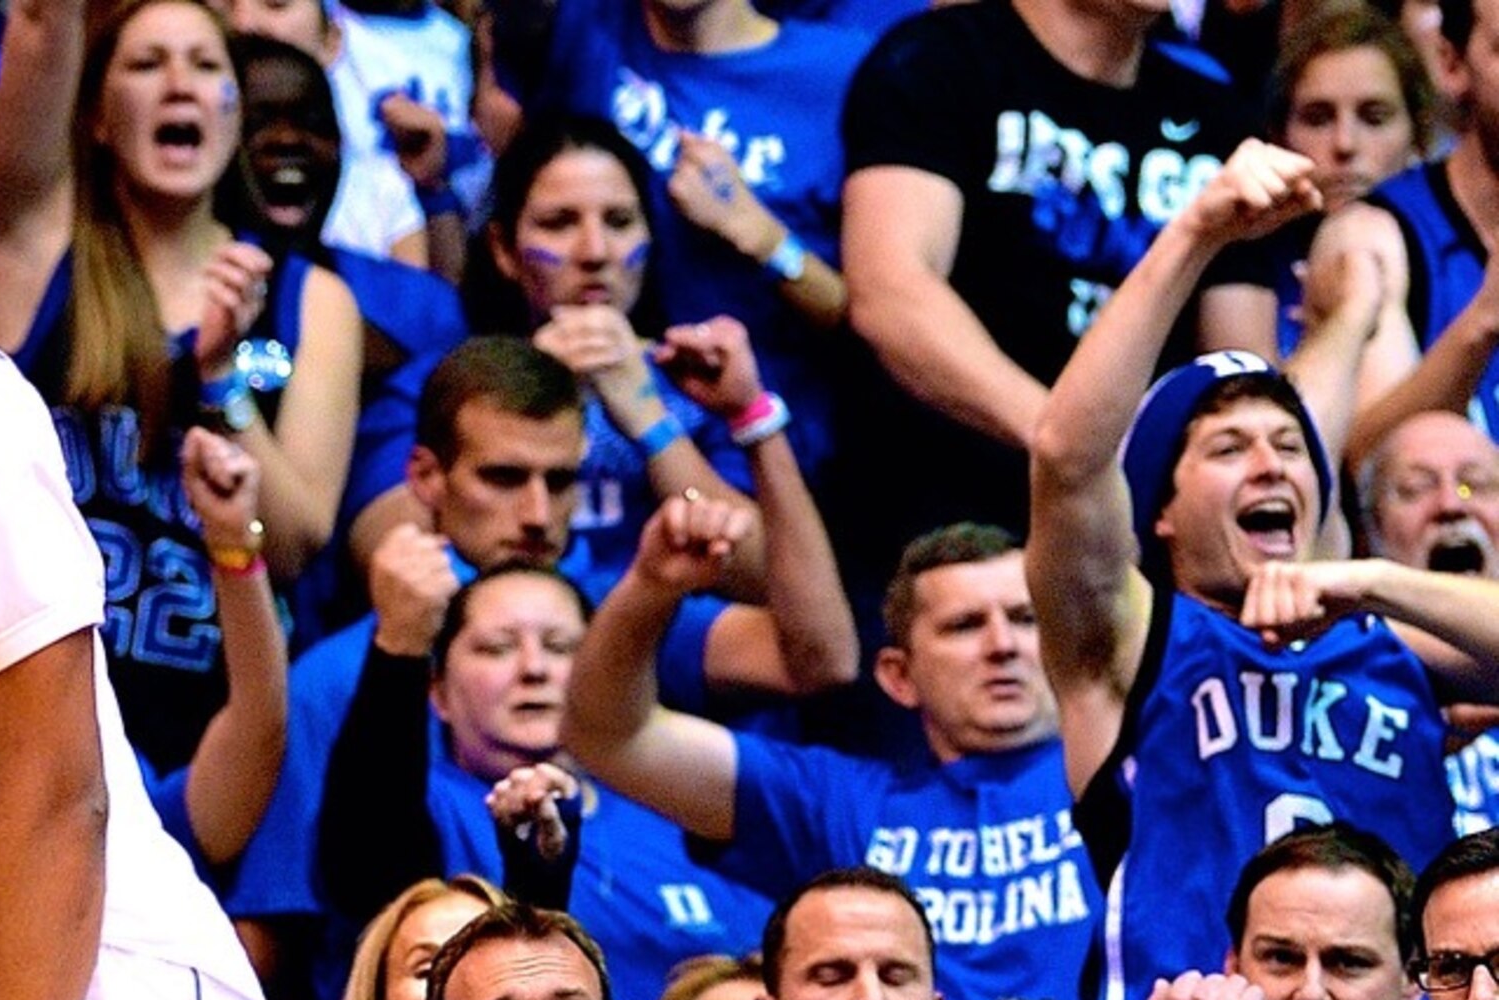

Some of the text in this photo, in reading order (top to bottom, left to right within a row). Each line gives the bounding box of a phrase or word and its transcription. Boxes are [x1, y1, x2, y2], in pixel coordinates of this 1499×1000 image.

[1191, 671, 1409, 779] DUKE
[865, 808, 1084, 878] GO TO HELL
[914, 859, 1091, 946] ROLINA
